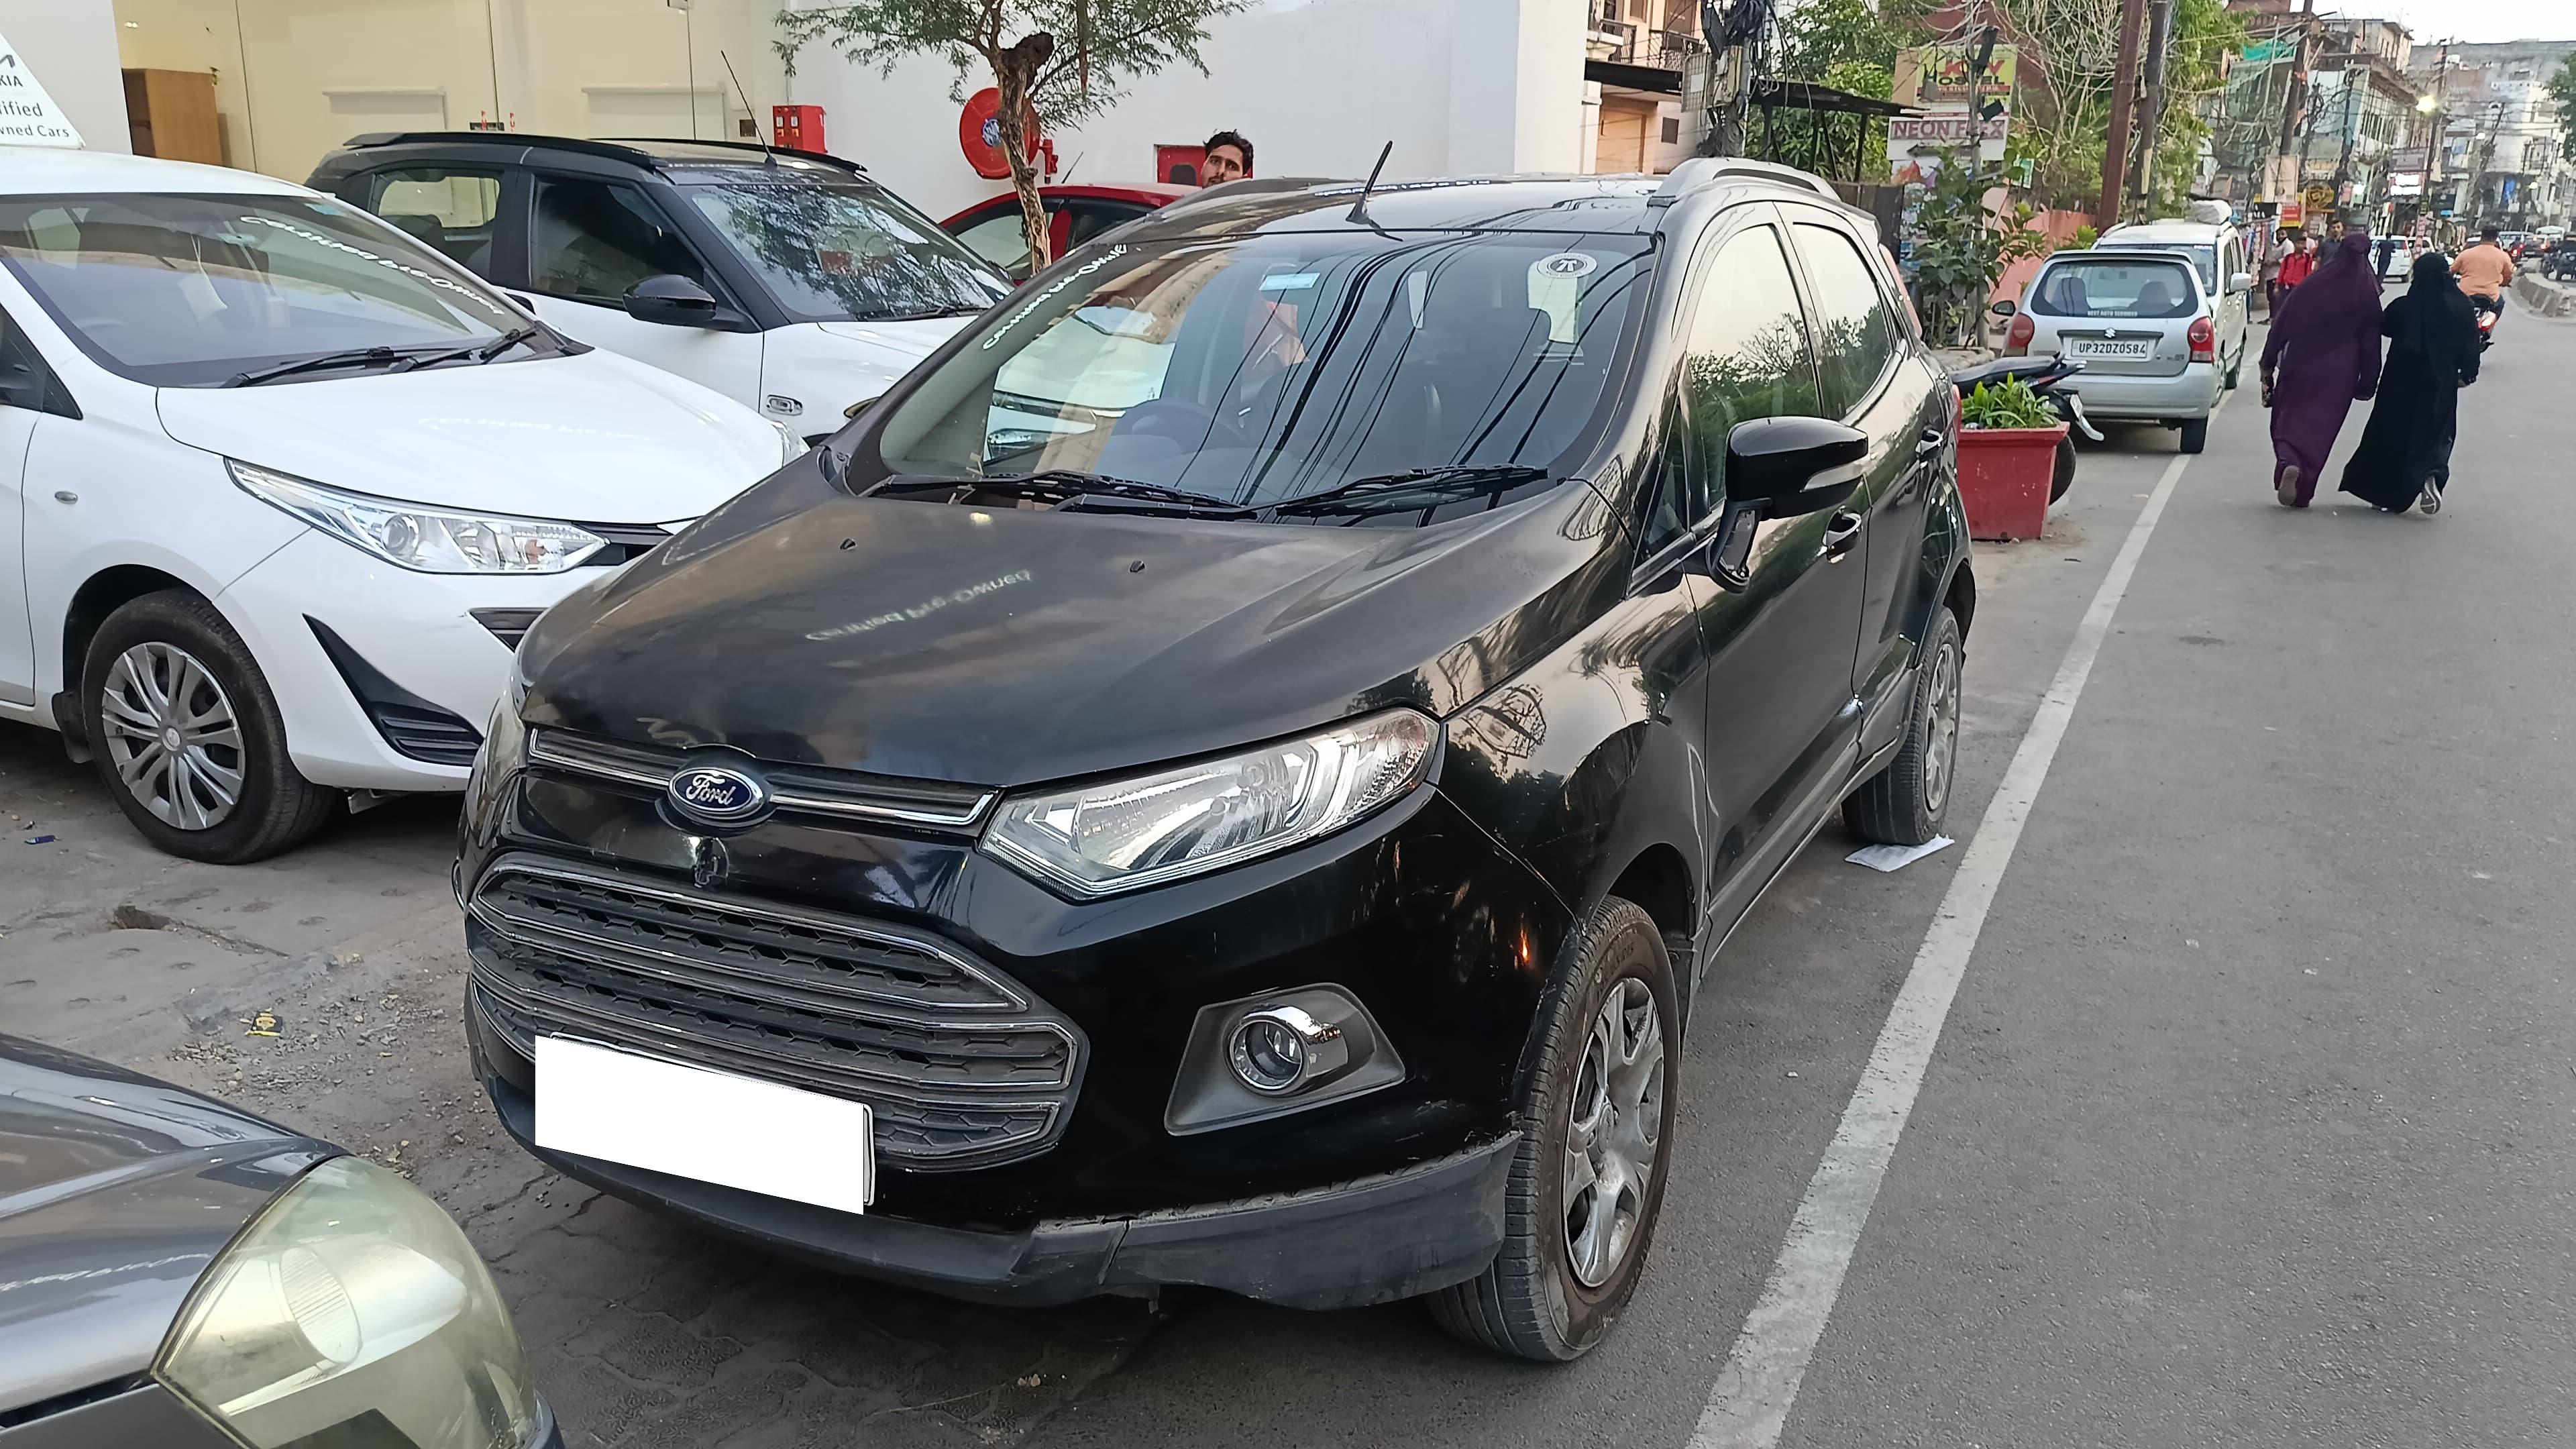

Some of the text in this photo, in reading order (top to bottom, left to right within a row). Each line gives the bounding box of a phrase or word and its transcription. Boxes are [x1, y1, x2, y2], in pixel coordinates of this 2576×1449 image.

[1923, 64, 2005, 85] HOSEL
[0, 101, 42, 117] ified
[37, 125, 70, 138] Cars
[1893, 121, 2005, 137] NEON FEX
[2079, 343, 2146, 354] UP32DZ0584
[686, 773, 737, 805] Ford
